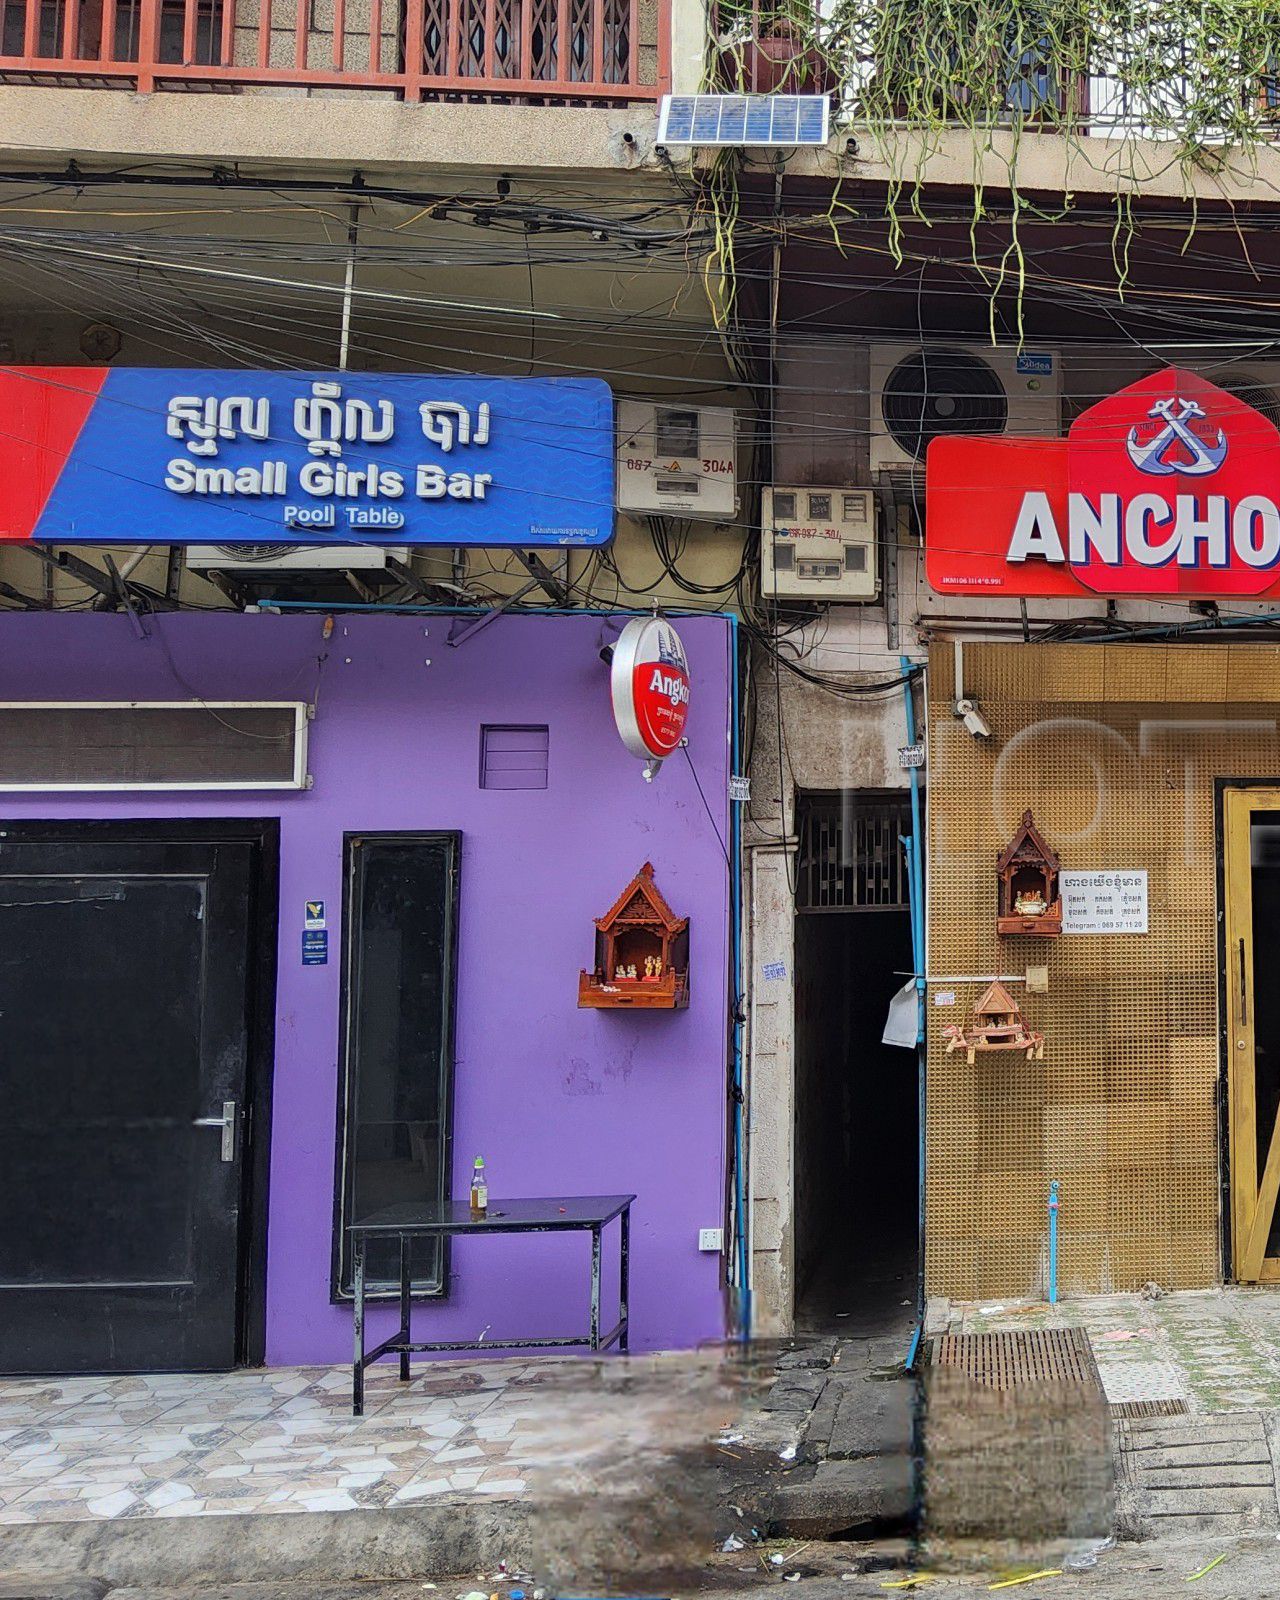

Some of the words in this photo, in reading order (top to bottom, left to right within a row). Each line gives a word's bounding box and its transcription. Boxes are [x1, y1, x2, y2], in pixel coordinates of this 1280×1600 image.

[164, 458, 288, 496] Small
[299, 461, 404, 497] Girls
[415, 464, 493, 499] Bar
[284, 505, 336, 527] Pool
[344, 506, 405, 529] Table
[649, 669, 689, 706] Angko
[1066, 922, 1096, 931] Telegram
